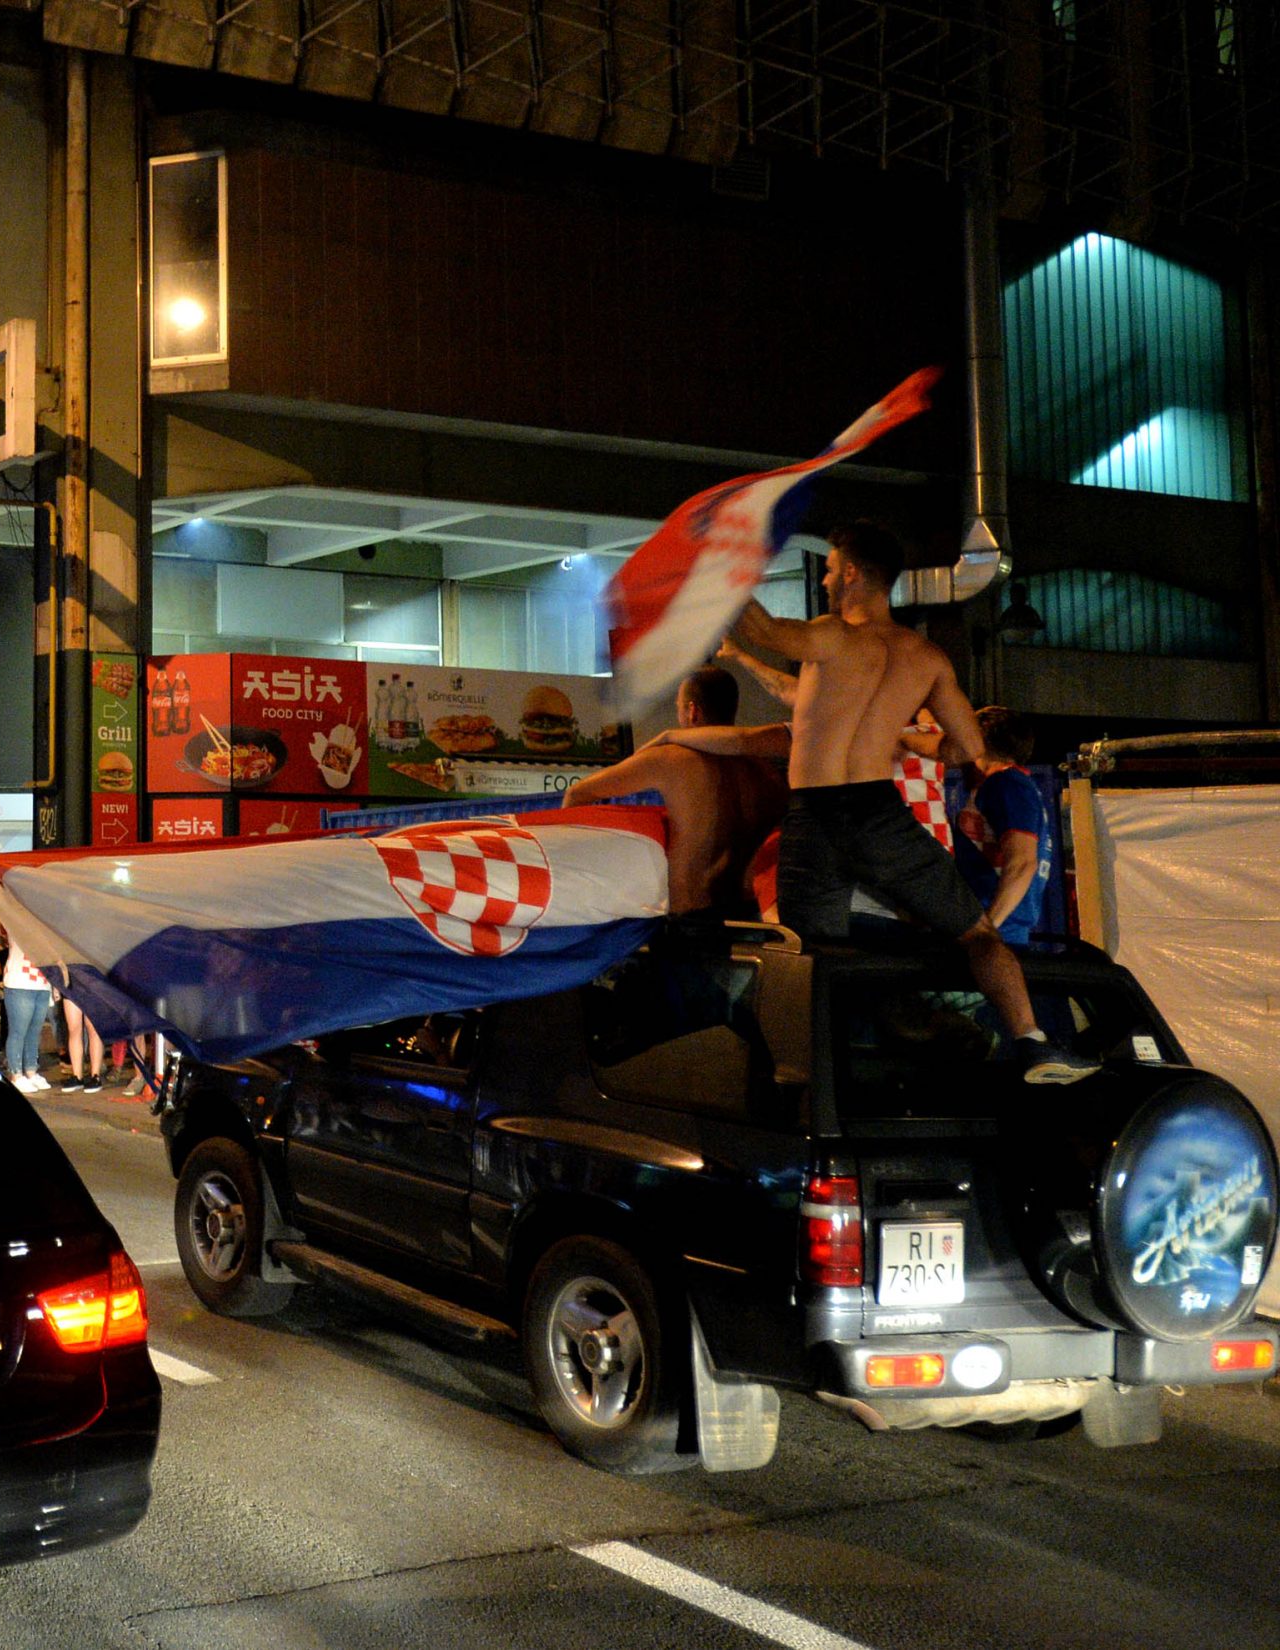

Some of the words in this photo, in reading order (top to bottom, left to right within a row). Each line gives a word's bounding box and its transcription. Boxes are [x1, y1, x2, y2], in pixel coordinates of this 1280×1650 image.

[242, 665, 343, 704] ASIA
[262, 708, 294, 719] FOOD
[296, 709, 323, 722] CITY
[97, 725, 133, 742] Grill
[101, 803, 129, 814] NEW!
[158, 816, 216, 837] ASIA
[909, 1231, 934, 1261] RI
